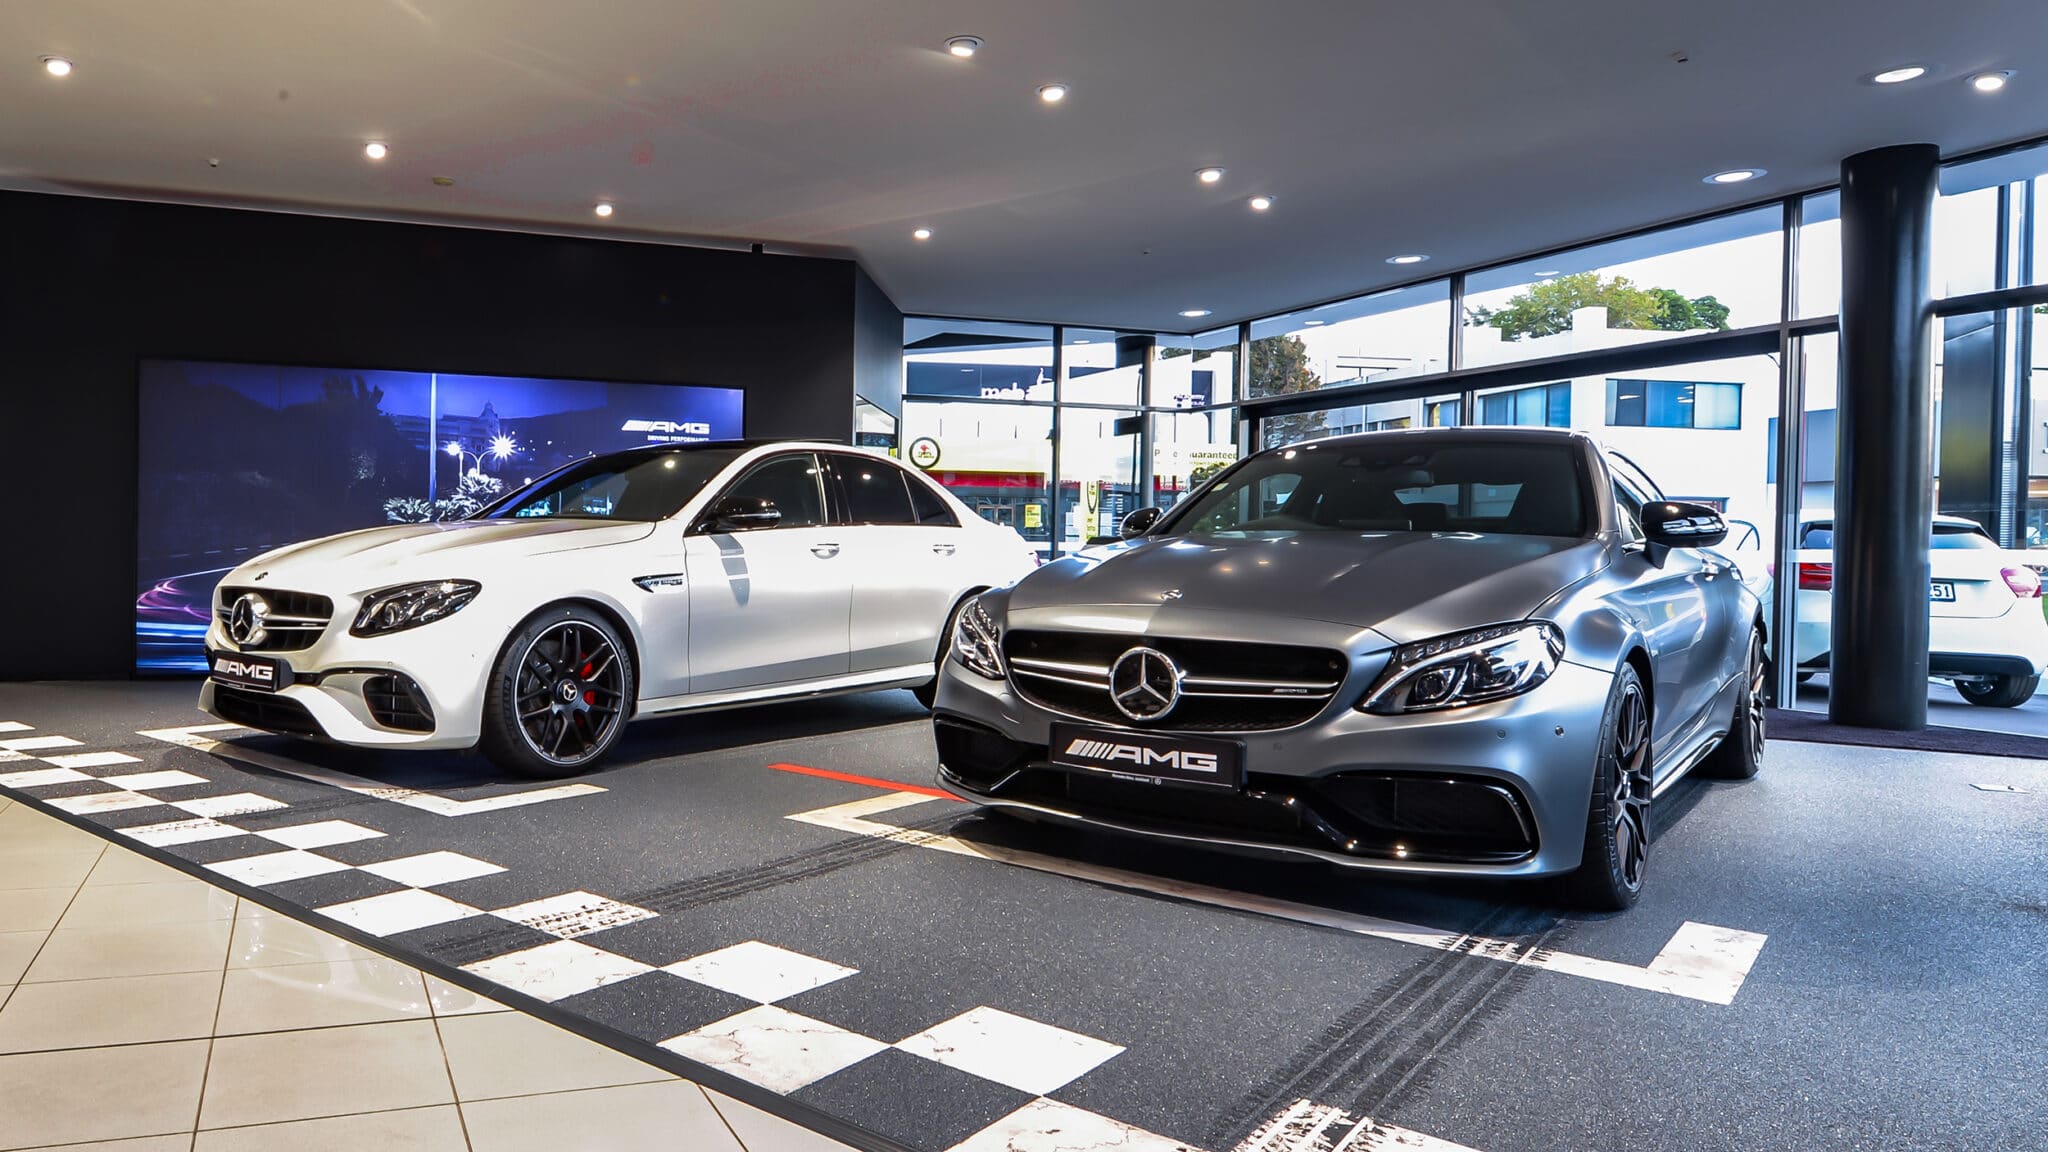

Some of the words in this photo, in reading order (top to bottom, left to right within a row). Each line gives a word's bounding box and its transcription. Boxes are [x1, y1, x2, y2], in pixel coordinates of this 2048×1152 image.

[648, 421, 710, 435] AMG
[227, 662, 273, 680] AMG
[1106, 743, 1218, 773] AMG
